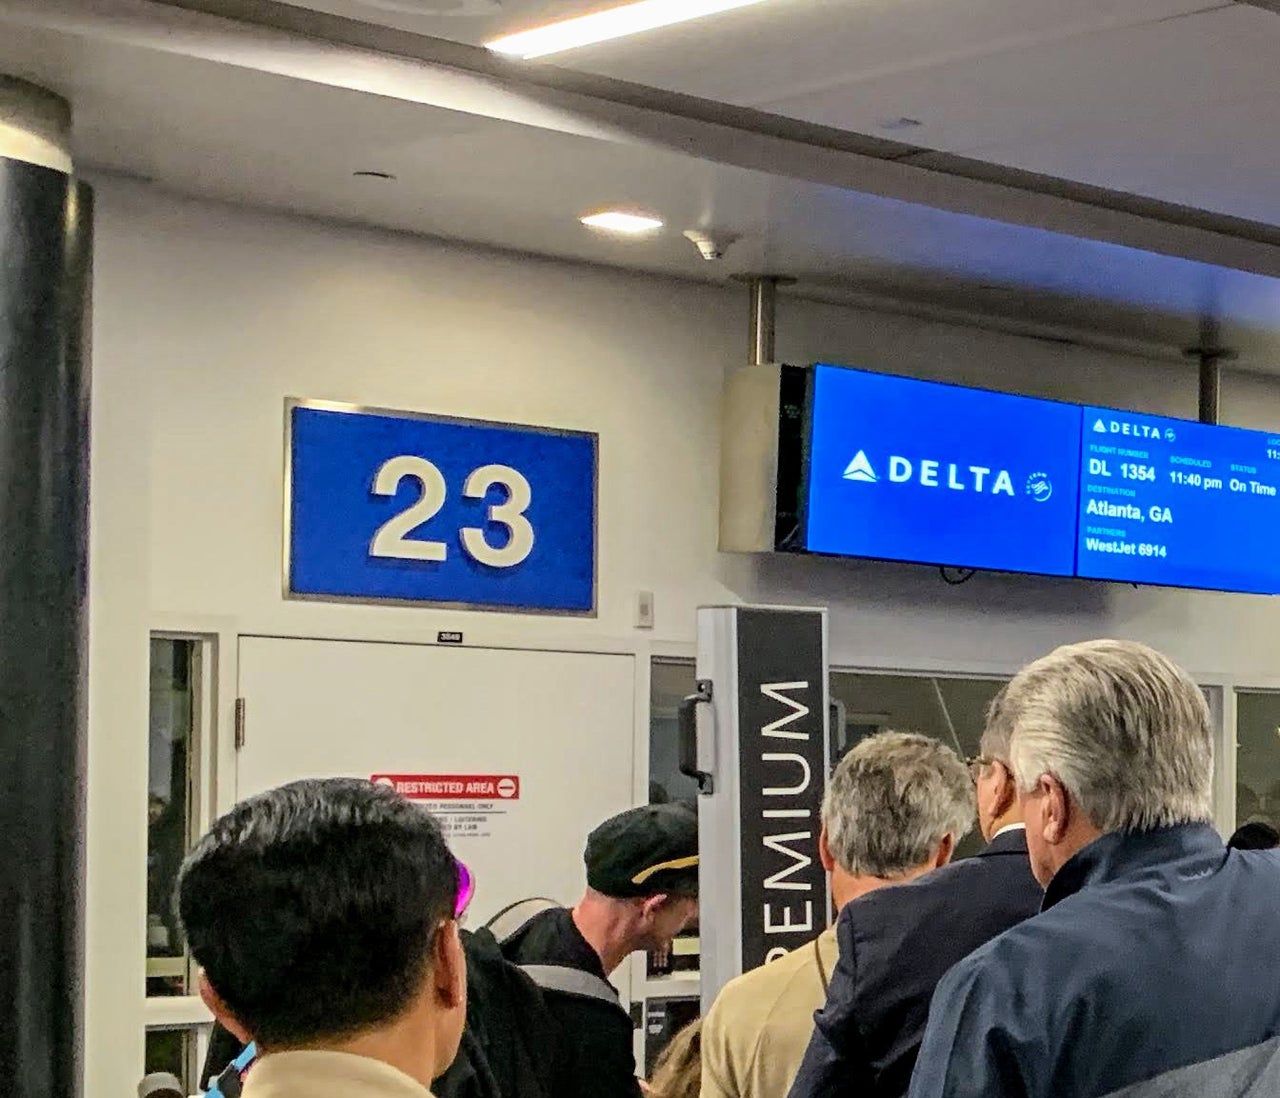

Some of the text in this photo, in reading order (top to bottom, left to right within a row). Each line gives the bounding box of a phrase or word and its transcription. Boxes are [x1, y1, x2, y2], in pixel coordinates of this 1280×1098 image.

[1110, 421, 1160, 440] DELTA
[889, 455, 1015, 496] DELTA
[1089, 458, 1156, 482] DL 1354
[1230, 464, 1257, 474] STATUS
[1169, 471, 1222, 490] 11:40 pm
[1229, 478, 1277, 496] On Time
[368, 454, 535, 568] 23
[1086, 498, 1173, 523] Atlanta, GA
[1086, 537, 1167, 558] WestJet 6914
[397, 781, 494, 794] RESTRICTED AREA
[760, 680, 814, 966] EMIUM
